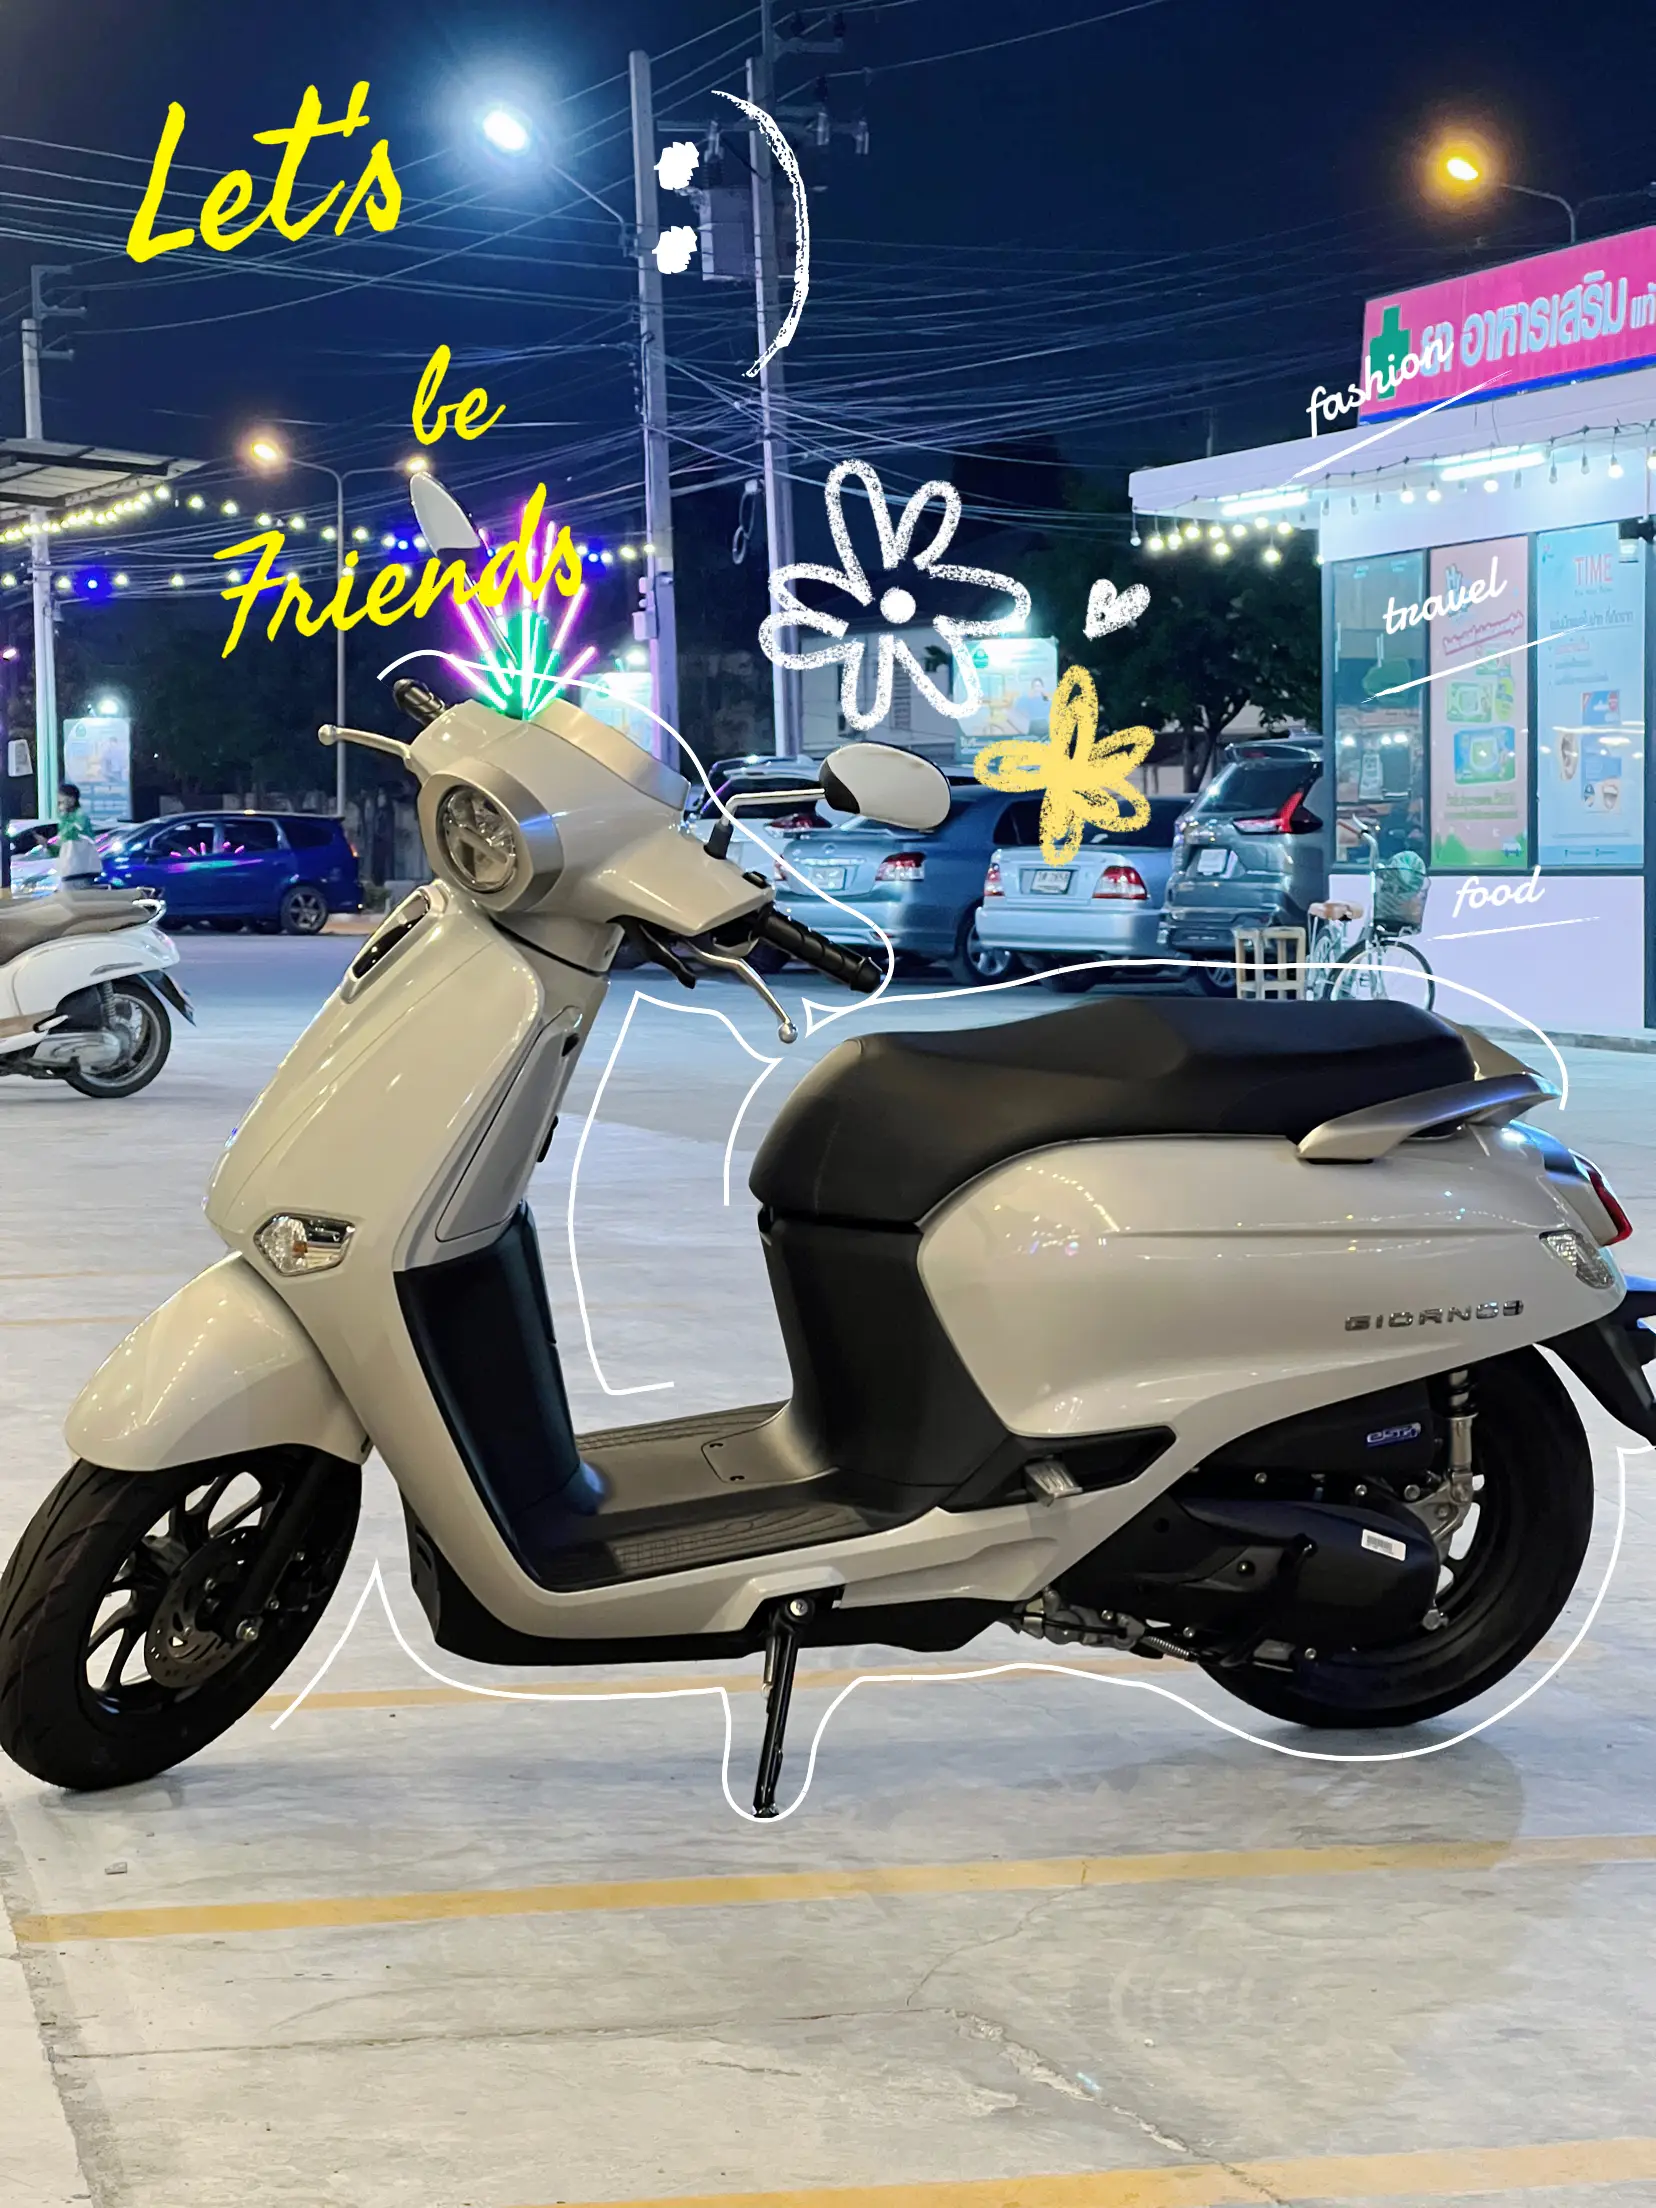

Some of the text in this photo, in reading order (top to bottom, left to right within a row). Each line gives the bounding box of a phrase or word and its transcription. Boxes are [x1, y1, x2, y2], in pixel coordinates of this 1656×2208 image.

[1461, 269, 1628, 367] อาหารเสริม
[1574, 553, 1613, 585] TIME
